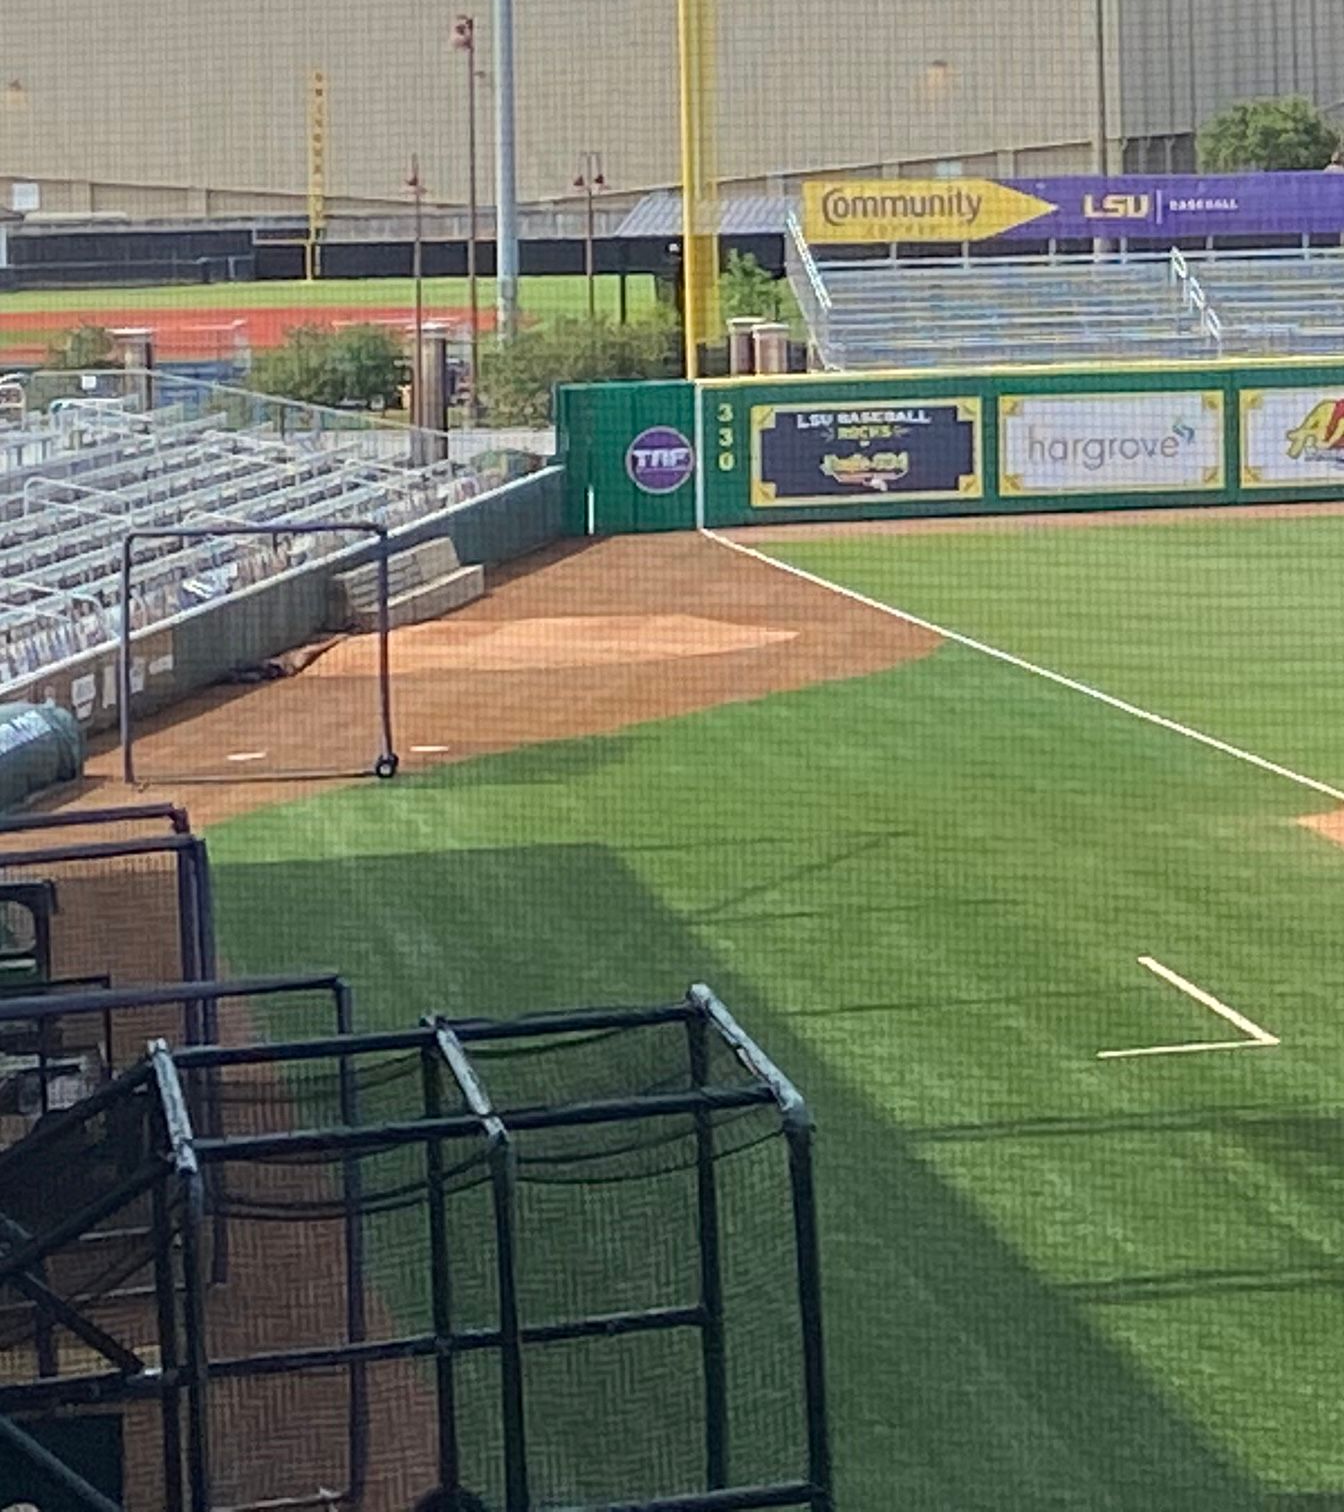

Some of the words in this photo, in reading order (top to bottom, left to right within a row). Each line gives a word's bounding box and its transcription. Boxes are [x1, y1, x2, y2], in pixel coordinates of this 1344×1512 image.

[822, 187, 982, 227] Community
[1083, 194, 1148, 218] LSU
[797, 413, 834, 429] LSU
[837, 409, 932, 424] BASEBALL
[1027, 424, 1181, 471] hargrove
